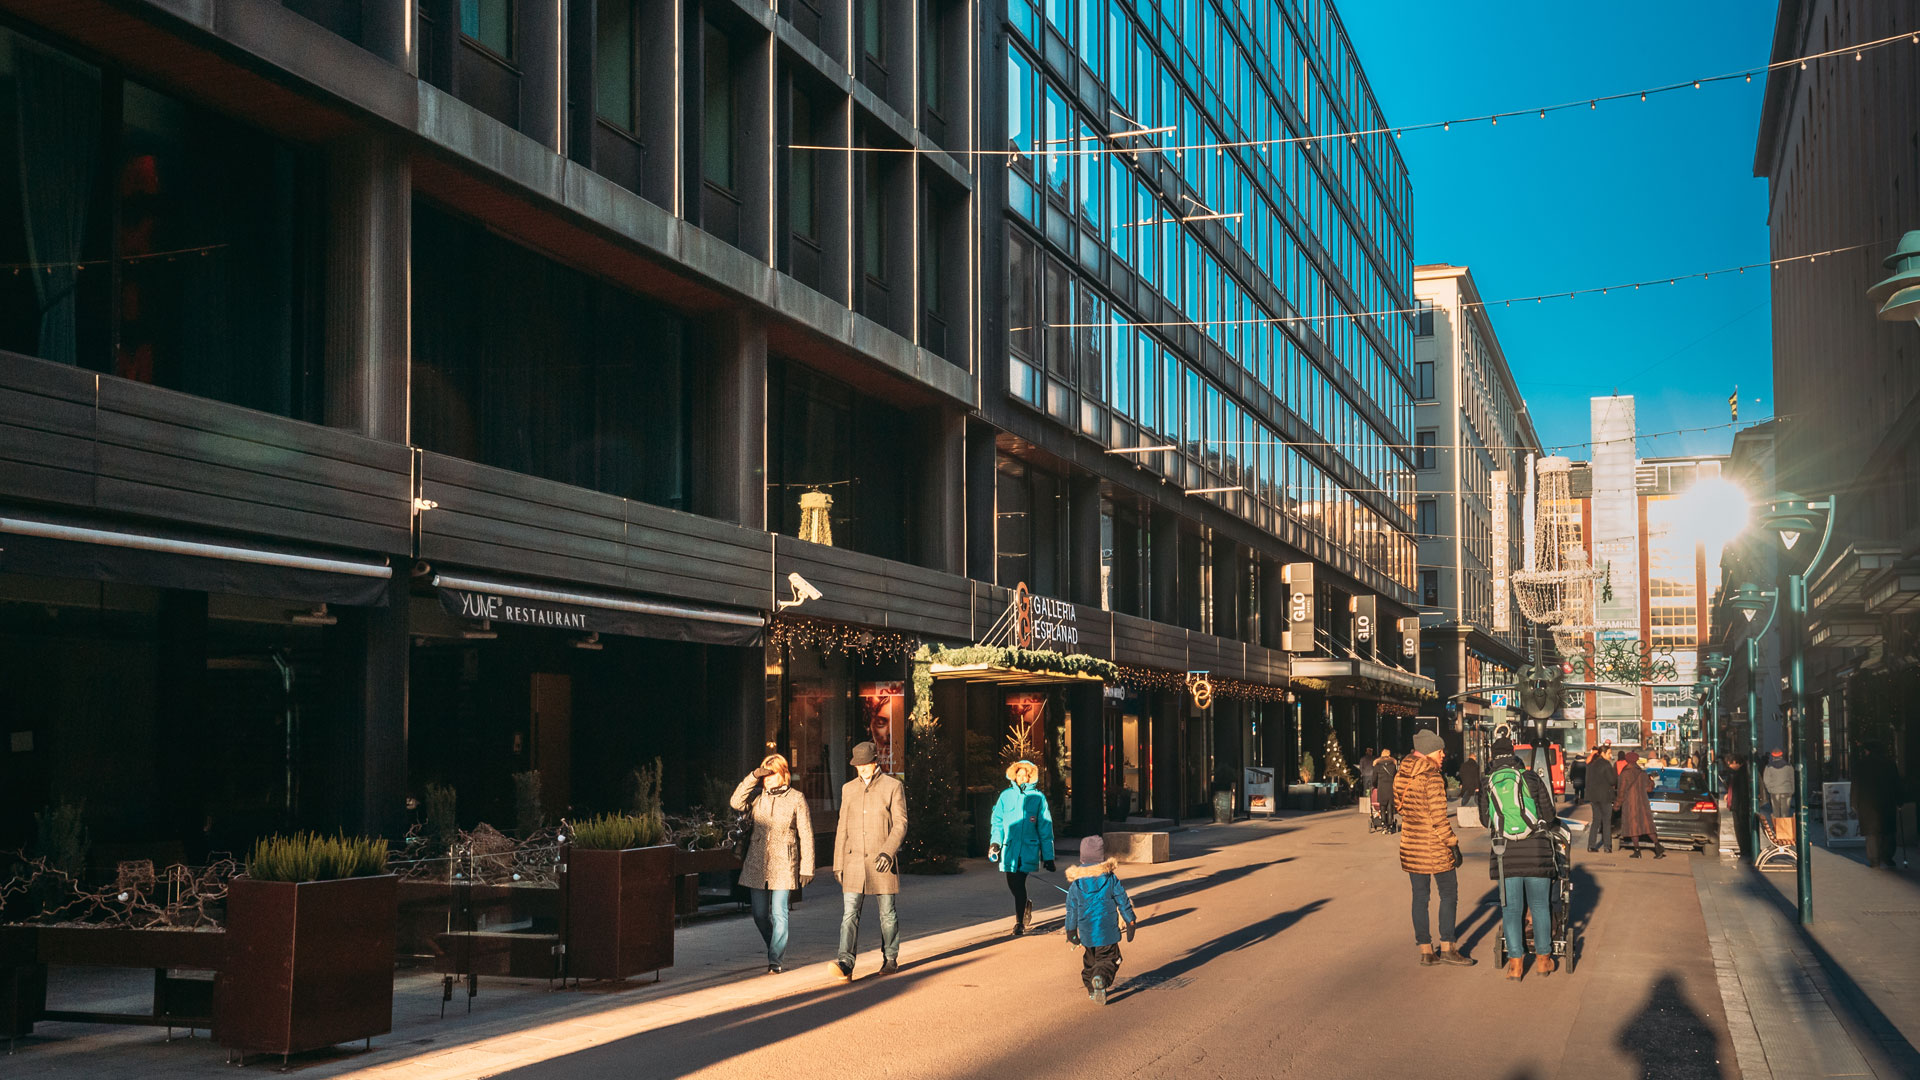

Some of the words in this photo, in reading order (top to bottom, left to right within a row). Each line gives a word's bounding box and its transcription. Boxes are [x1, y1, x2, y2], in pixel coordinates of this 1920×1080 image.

[1495, 480, 1505, 624] Handelsbanken
[506, 606, 586, 628] RESTAURANT
[1033, 595, 1076, 622] GALLERIA
[1293, 592, 1306, 622] GLO
[1034, 620, 1078, 645] ESPLANAD
[1357, 615, 1370, 643] GLO
[1405, 638, 1414, 659] GLO
